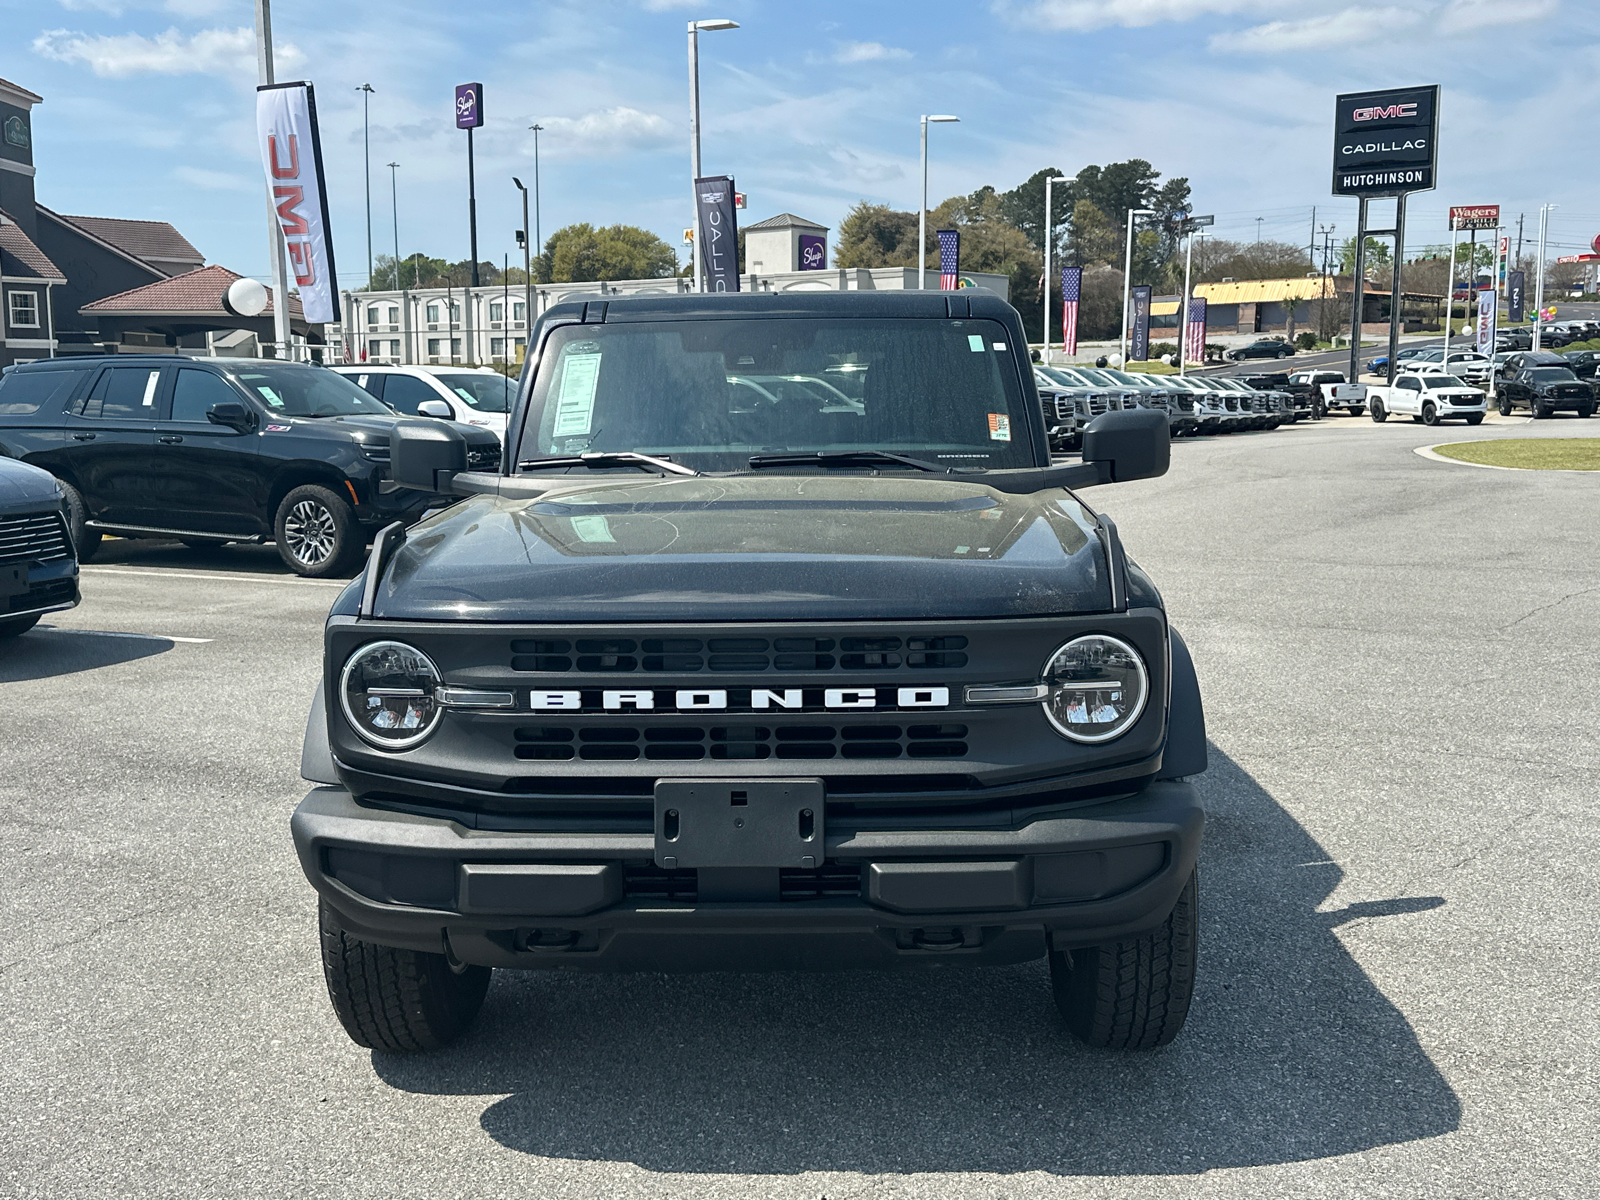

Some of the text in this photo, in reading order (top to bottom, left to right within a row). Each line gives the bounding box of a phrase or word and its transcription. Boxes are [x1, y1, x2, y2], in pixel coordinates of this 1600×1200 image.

[1353, 102, 1418, 122] GMC
[1342, 139, 1426, 155] CADILLAC
[1343, 170, 1423, 187] HUTCHINSON
[1453, 207, 1497, 219] Wagers
[803, 247, 822, 265] Sleep
[530, 687, 950, 710] BRONCO
